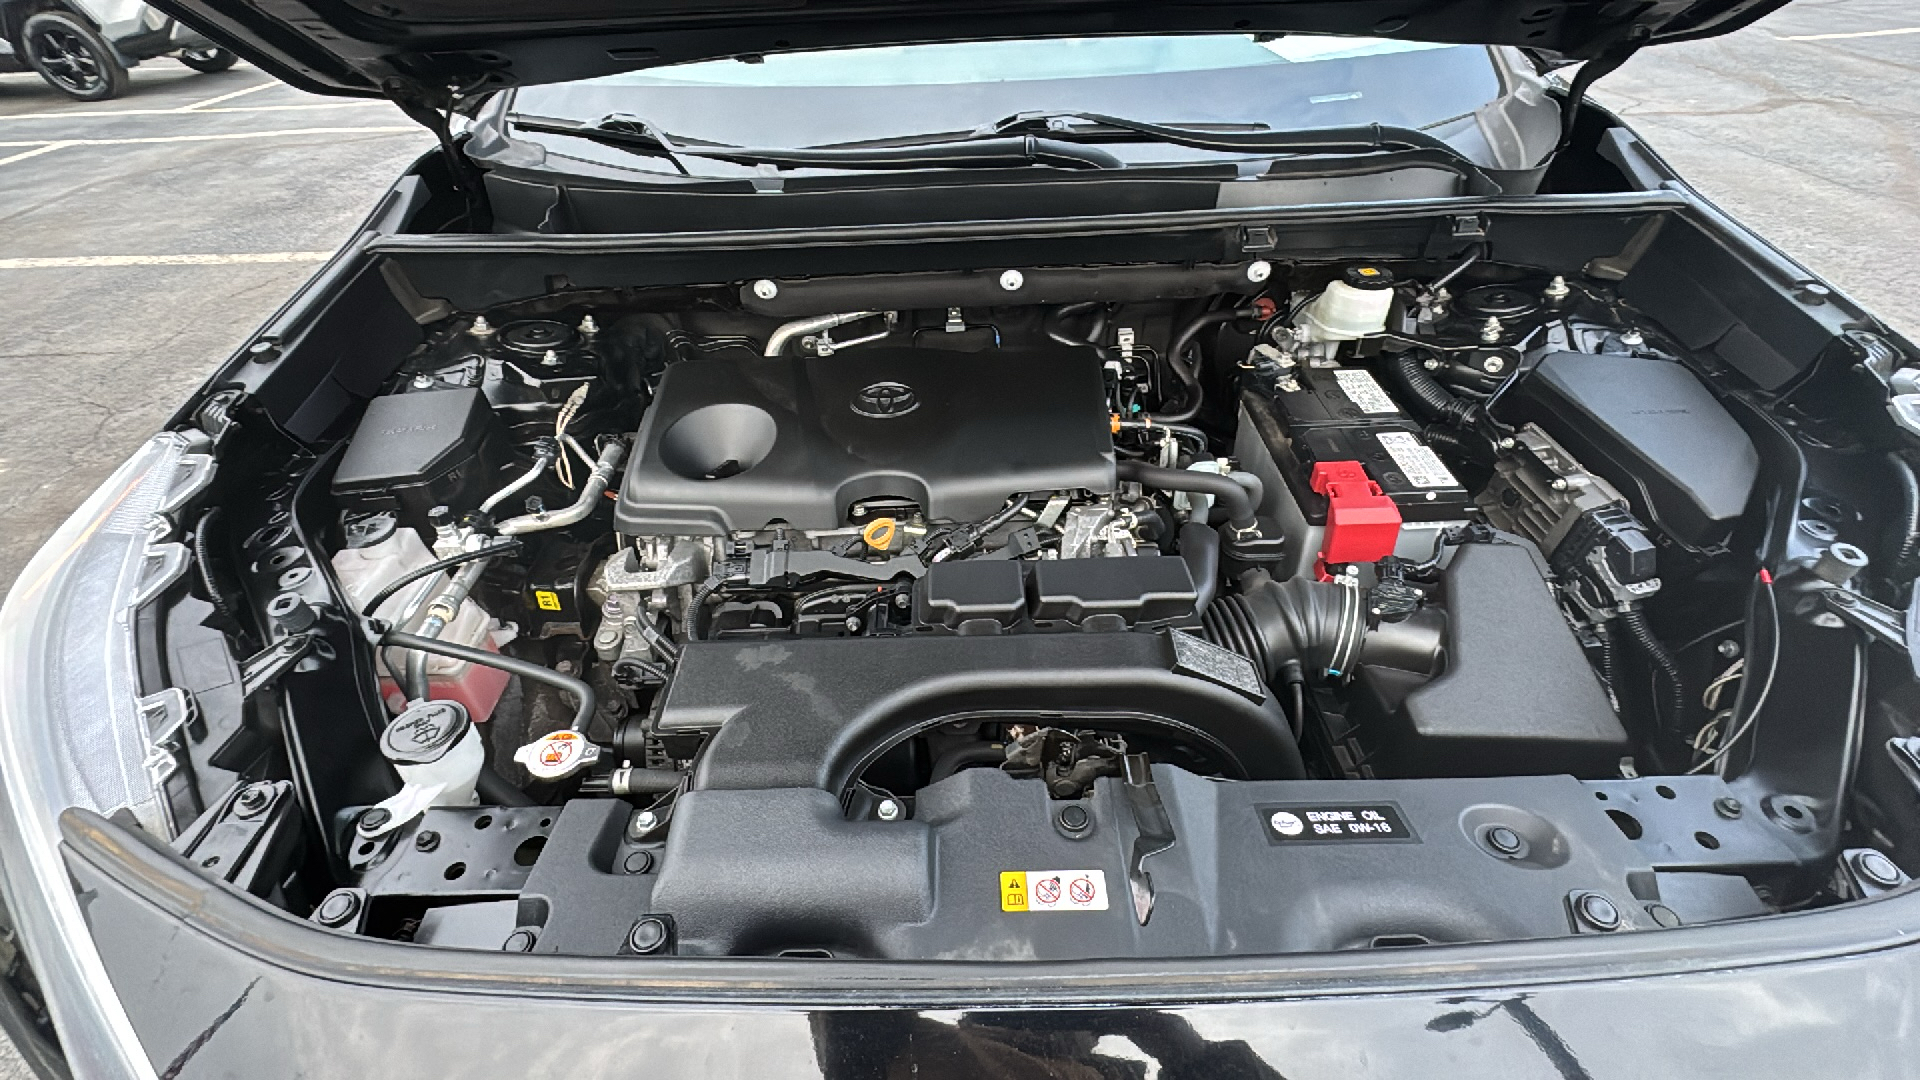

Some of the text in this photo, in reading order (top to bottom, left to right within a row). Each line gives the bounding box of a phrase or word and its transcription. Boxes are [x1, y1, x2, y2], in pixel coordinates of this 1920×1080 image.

[540, 595, 552, 606] R1
[1306, 810, 1386, 822] ENGINE OIL
[1313, 823, 1392, 834] SAE 0W-16
